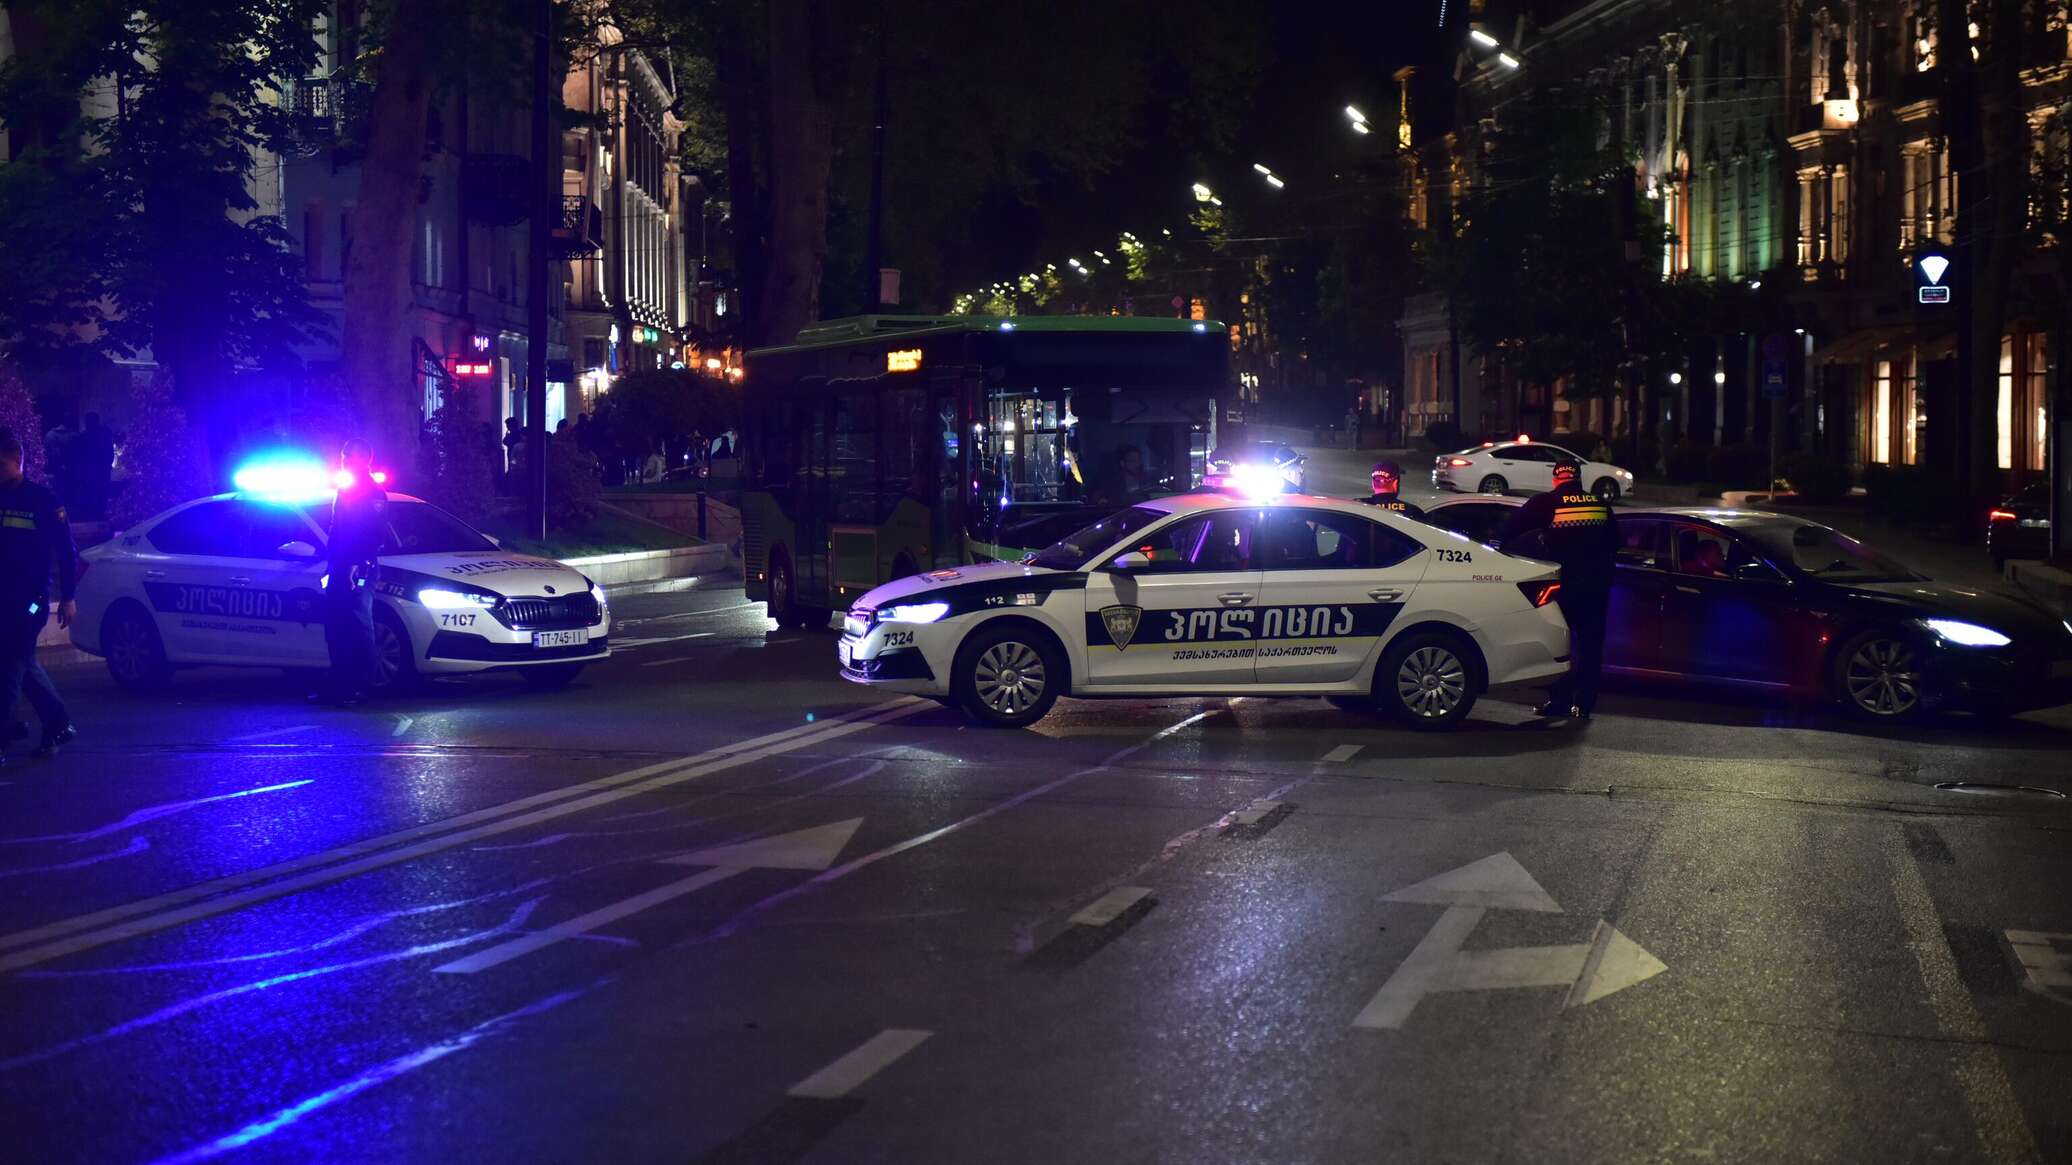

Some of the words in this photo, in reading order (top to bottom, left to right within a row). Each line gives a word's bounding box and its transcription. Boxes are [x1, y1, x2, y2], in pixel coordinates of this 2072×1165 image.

[1562, 495, 1599, 503] POLICE
[1375, 502, 1406, 511] OLICE
[1436, 549, 1472, 563] 7324
[176, 586, 282, 618] პოლიცია
[984, 596, 1005, 606] 112
[441, 614, 476, 626] 7107
[1165, 607, 1354, 641] პოლიცია
[884, 632, 914, 646] 7324
[1173, 649, 1255, 661] ვემსახურებით
[1258, 645, 1338, 657] საქართველოს
